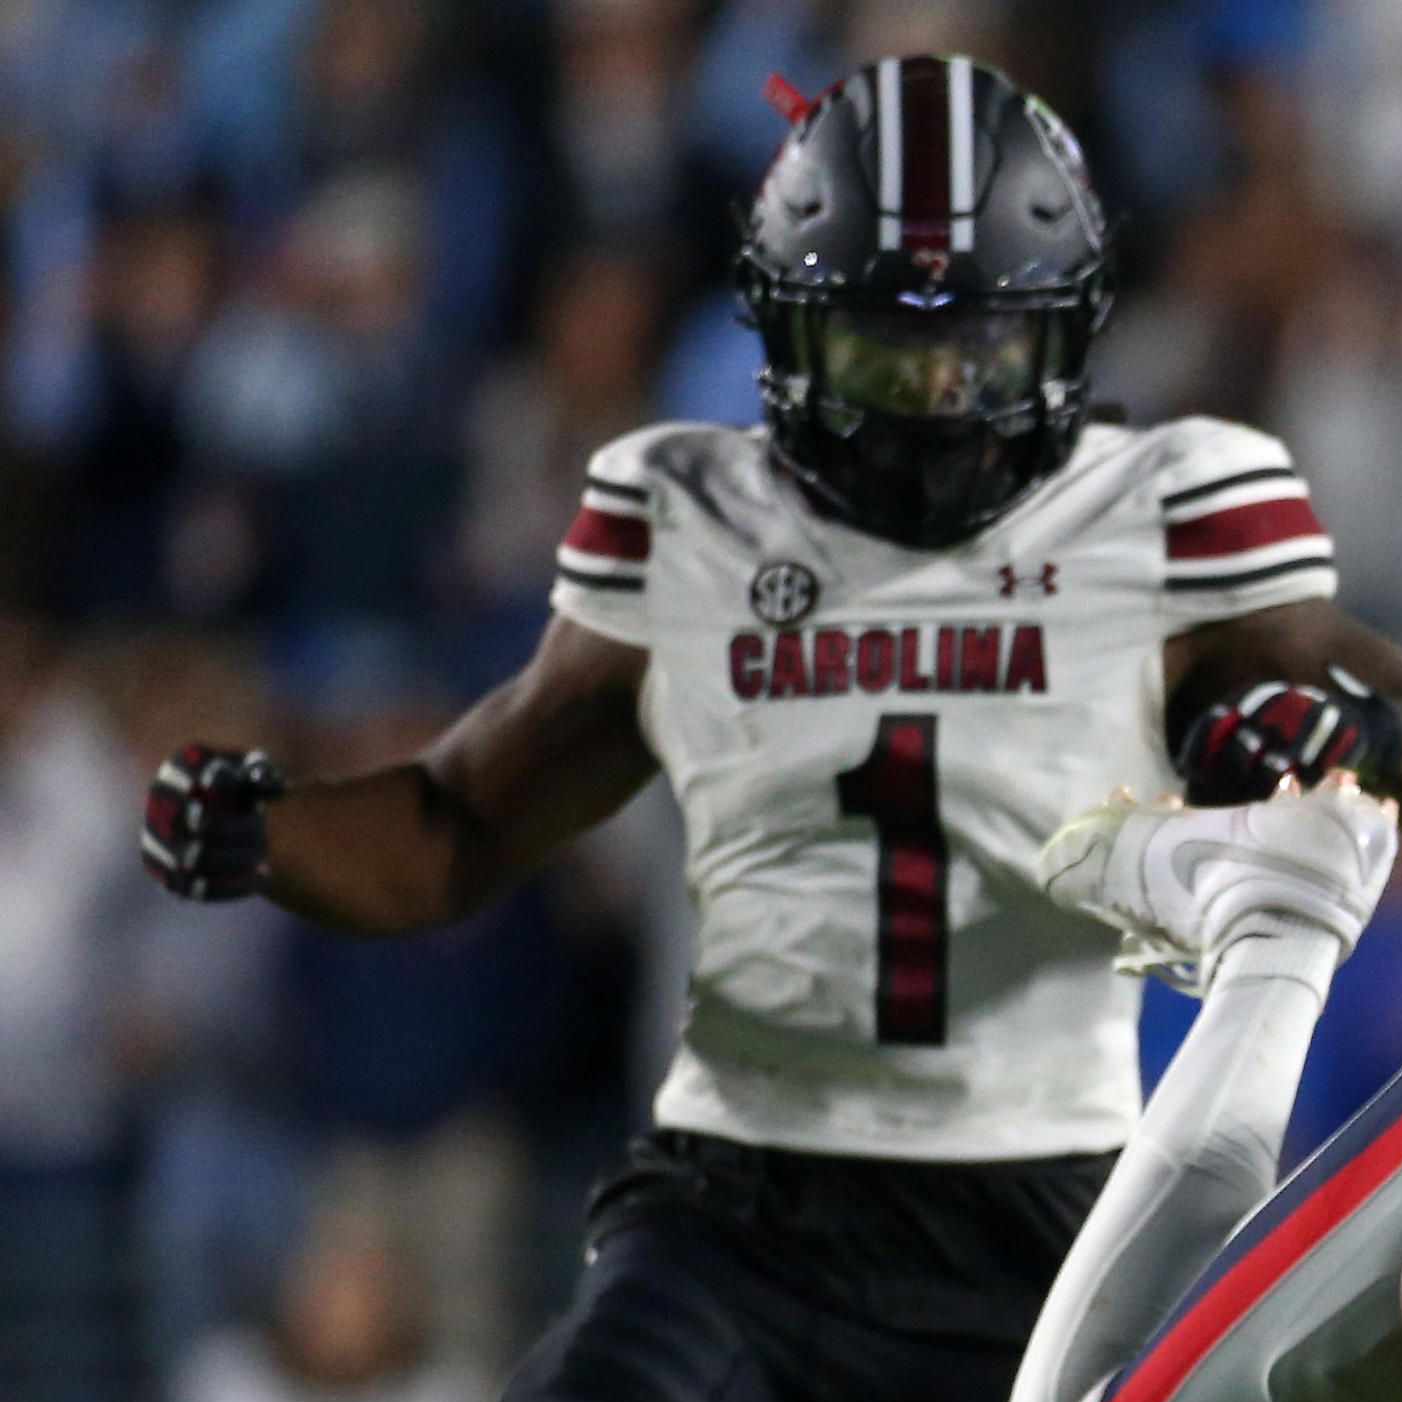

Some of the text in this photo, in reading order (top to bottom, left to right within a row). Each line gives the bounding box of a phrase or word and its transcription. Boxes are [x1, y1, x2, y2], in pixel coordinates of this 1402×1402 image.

[753, 563, 816, 623] SEC
[729, 624, 1047, 700] CAROLINA
[836, 713, 948, 1046] 1
